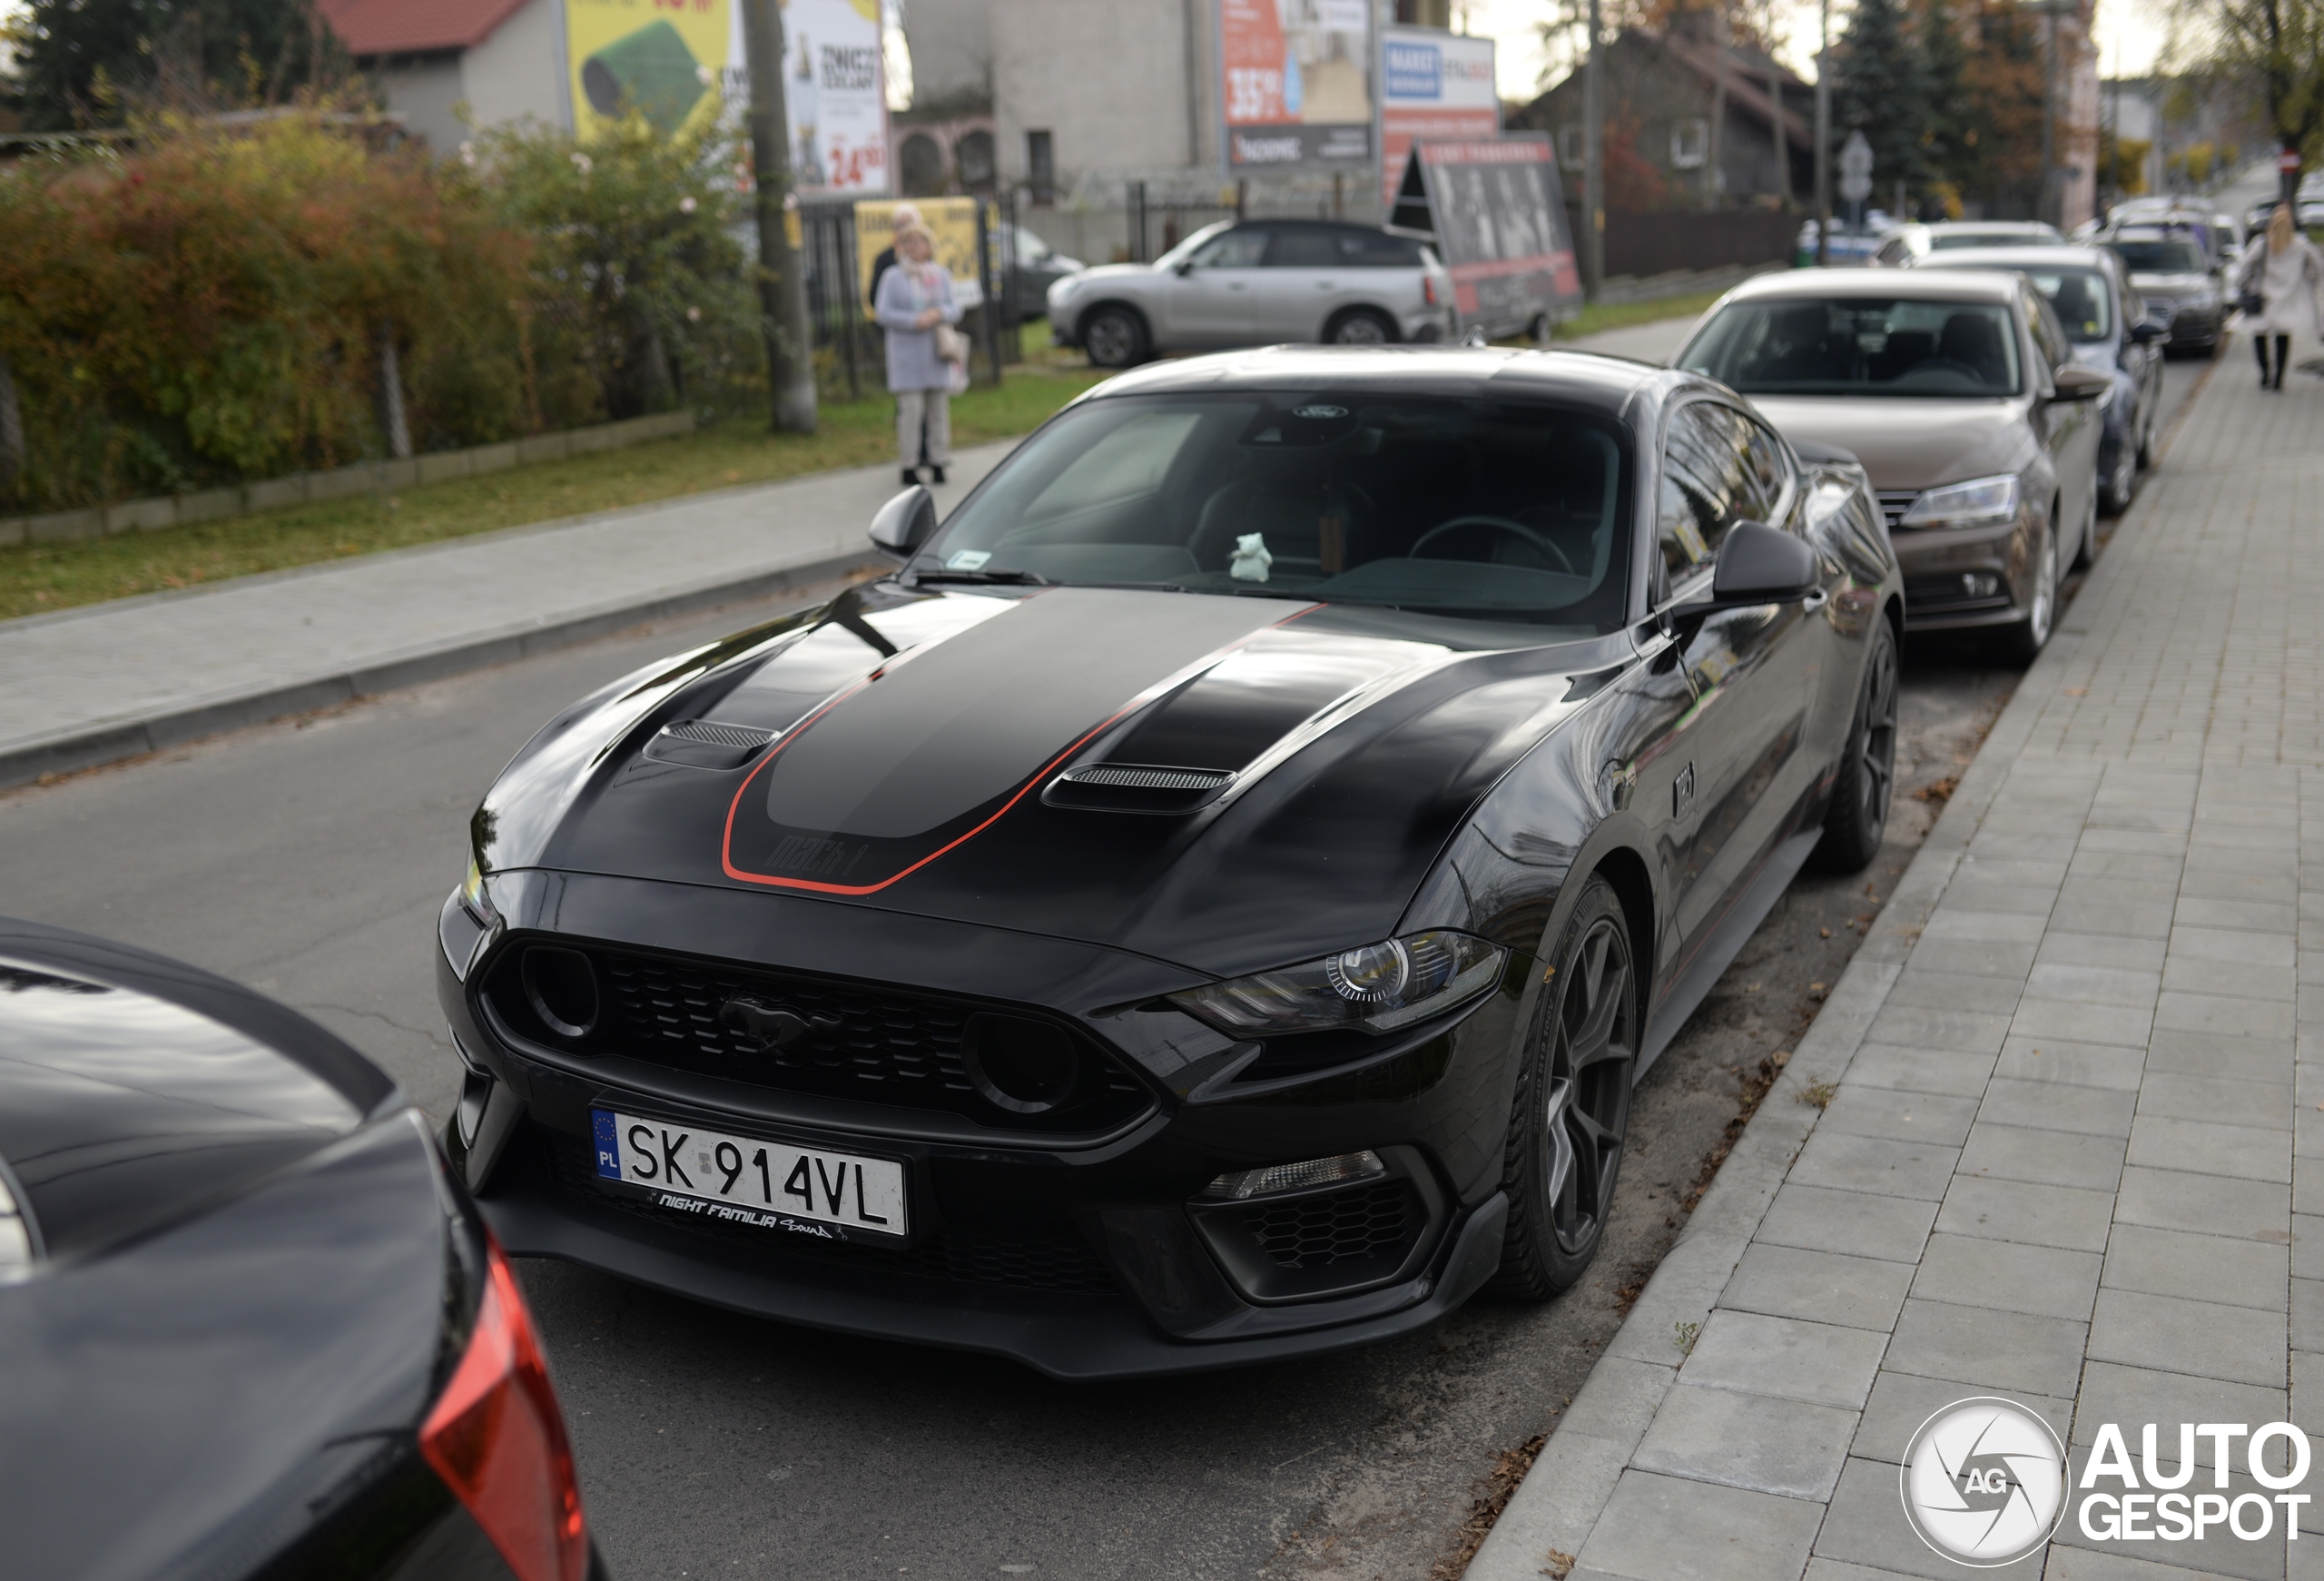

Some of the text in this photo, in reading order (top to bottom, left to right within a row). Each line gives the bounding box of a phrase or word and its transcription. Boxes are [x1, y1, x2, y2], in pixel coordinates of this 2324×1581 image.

[599, 1151, 617, 1169] PL
[627, 1124, 888, 1225] SK 914VL
[659, 1194, 707, 1213] NIGHT
[707, 1204, 776, 1228] FAMILIA
